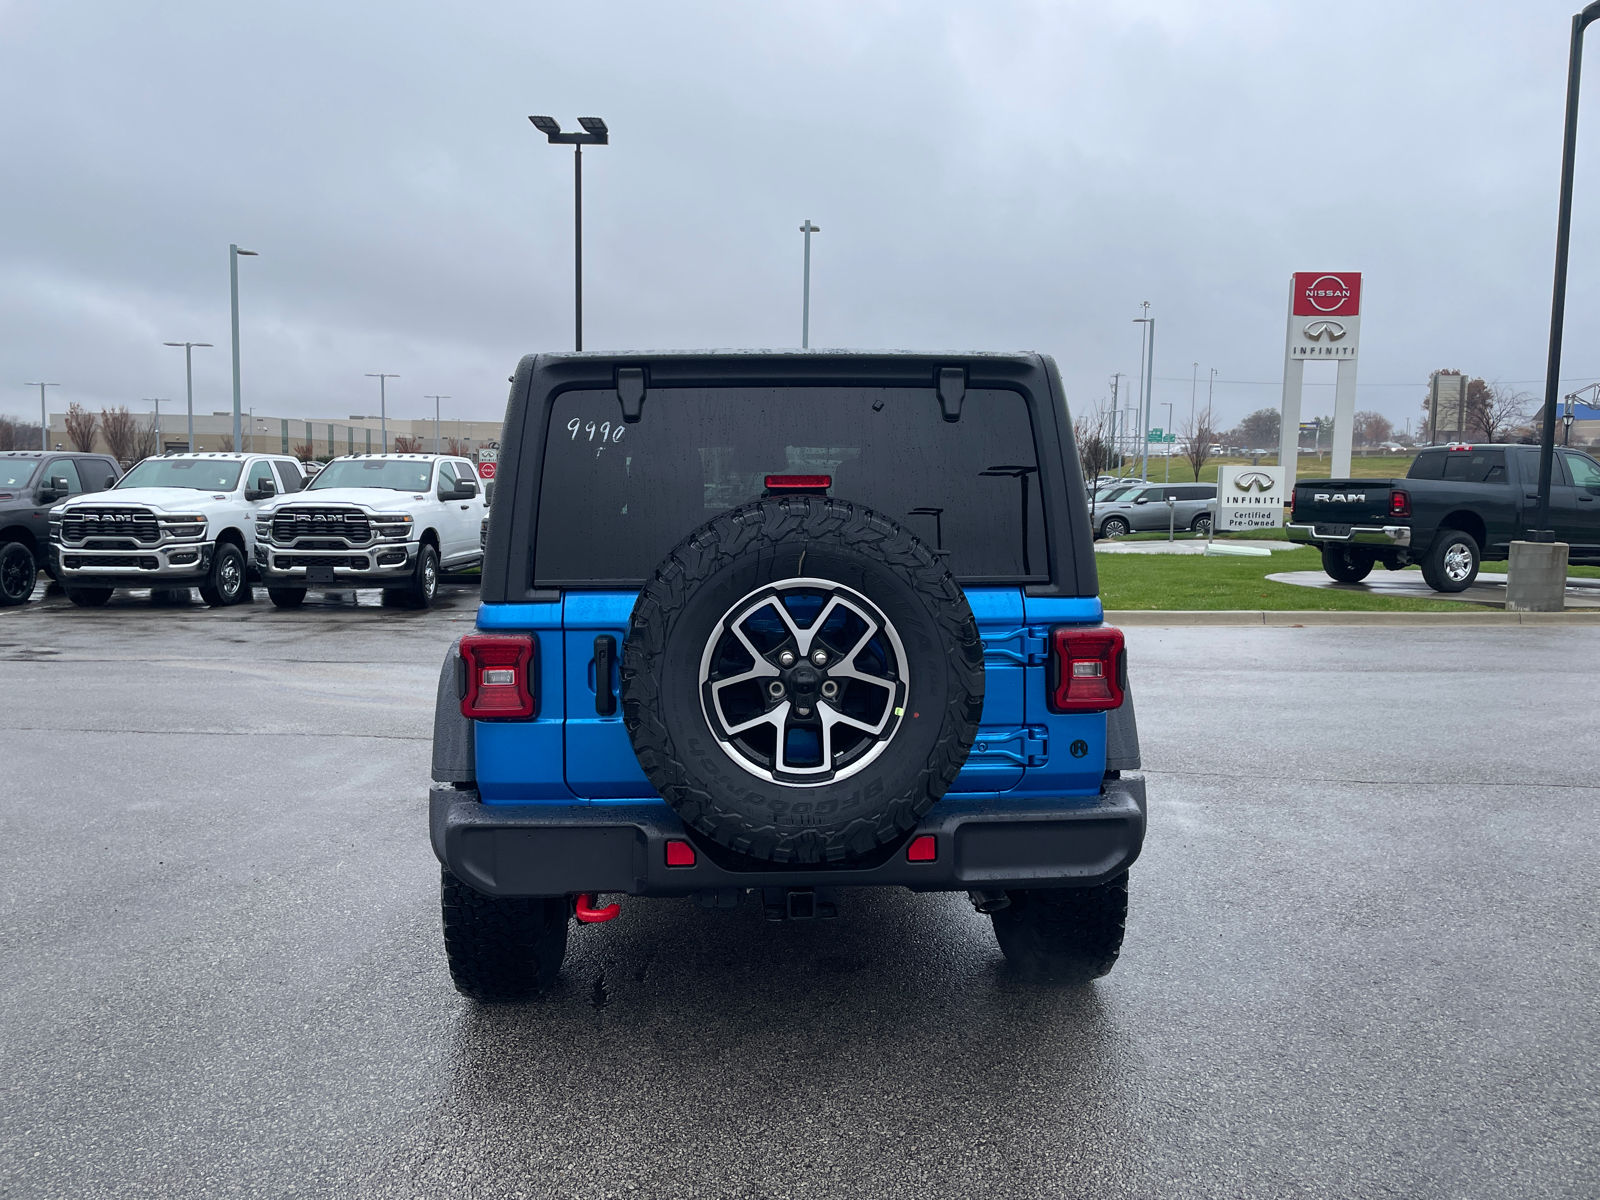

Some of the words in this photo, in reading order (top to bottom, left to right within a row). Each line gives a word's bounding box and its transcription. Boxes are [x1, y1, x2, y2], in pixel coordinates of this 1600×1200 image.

[1293, 346, 1355, 355] INFINITI
[567, 417, 626, 443] 9990
[1226, 496, 1280, 504] INFINITI
[1313, 493, 1366, 503] RAM
[84, 514, 132, 522] RAM
[296, 514, 343, 522] RAM
[1234, 511, 1271, 519] Certified
[1229, 519, 1275, 527] Pre-Owned
